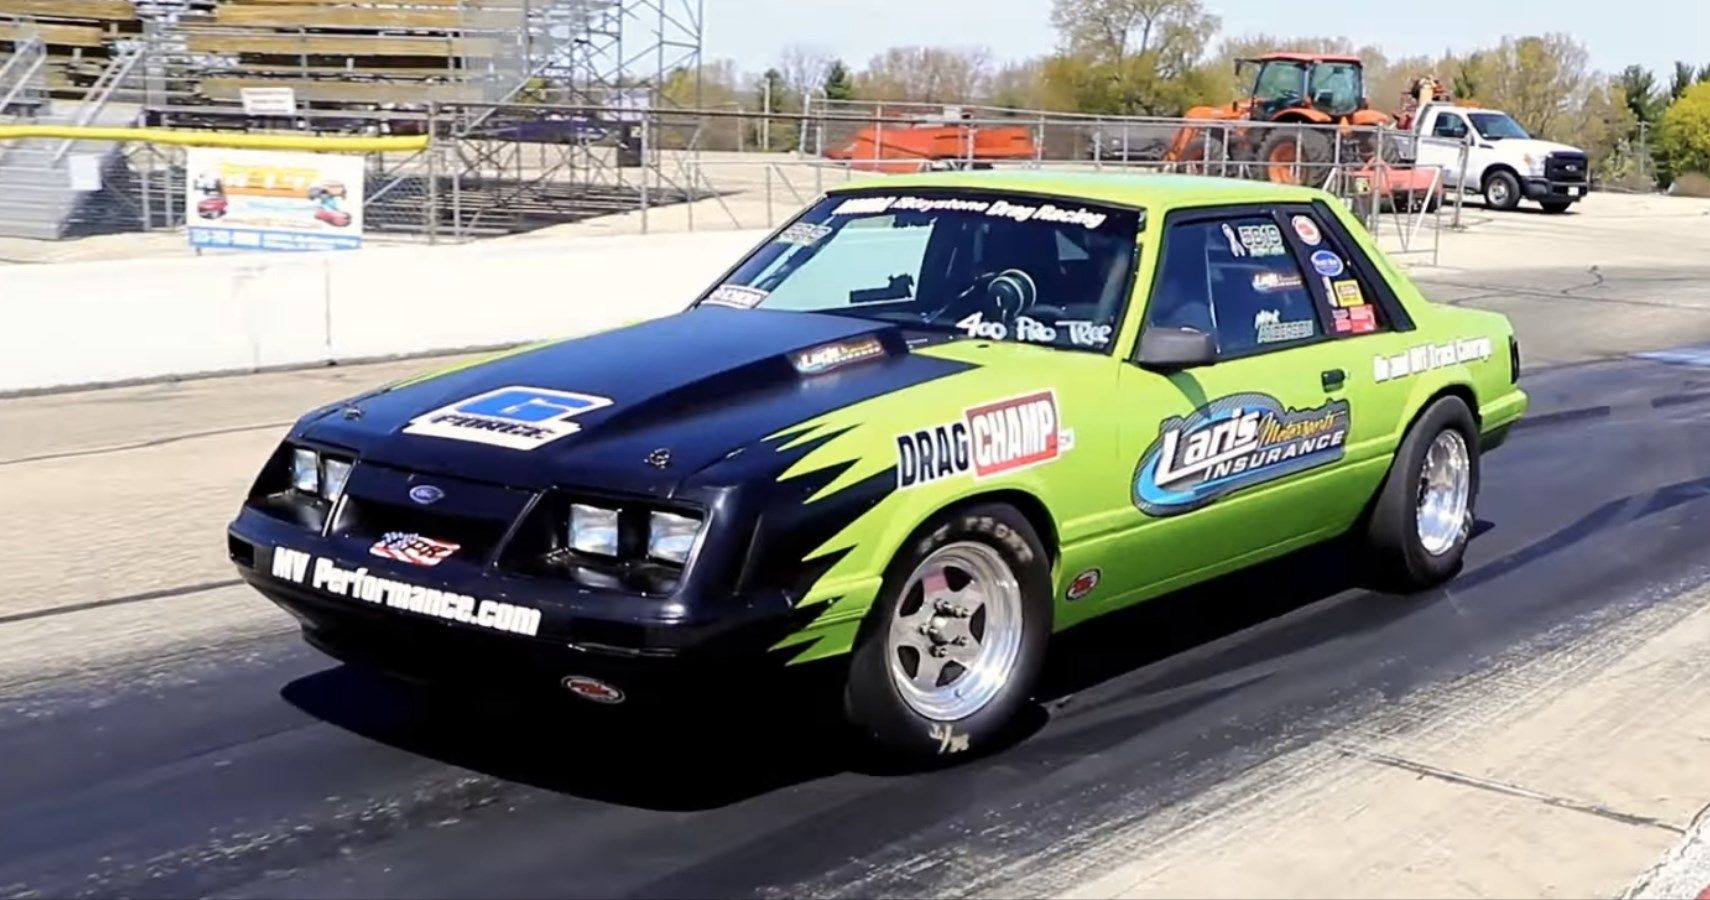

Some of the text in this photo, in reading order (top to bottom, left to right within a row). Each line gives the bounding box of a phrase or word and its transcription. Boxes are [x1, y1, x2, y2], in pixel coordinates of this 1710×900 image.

[986, 200, 1036, 222] Drag
[1033, 204, 1107, 229] Racing
[955, 311, 1008, 340] 400
[897, 399, 1055, 488] DRAG CHAMP
[1153, 408, 1261, 487] Laris
[1203, 430, 1345, 482] INSURANCE
[272, 546, 542, 637] MV Performance.com
